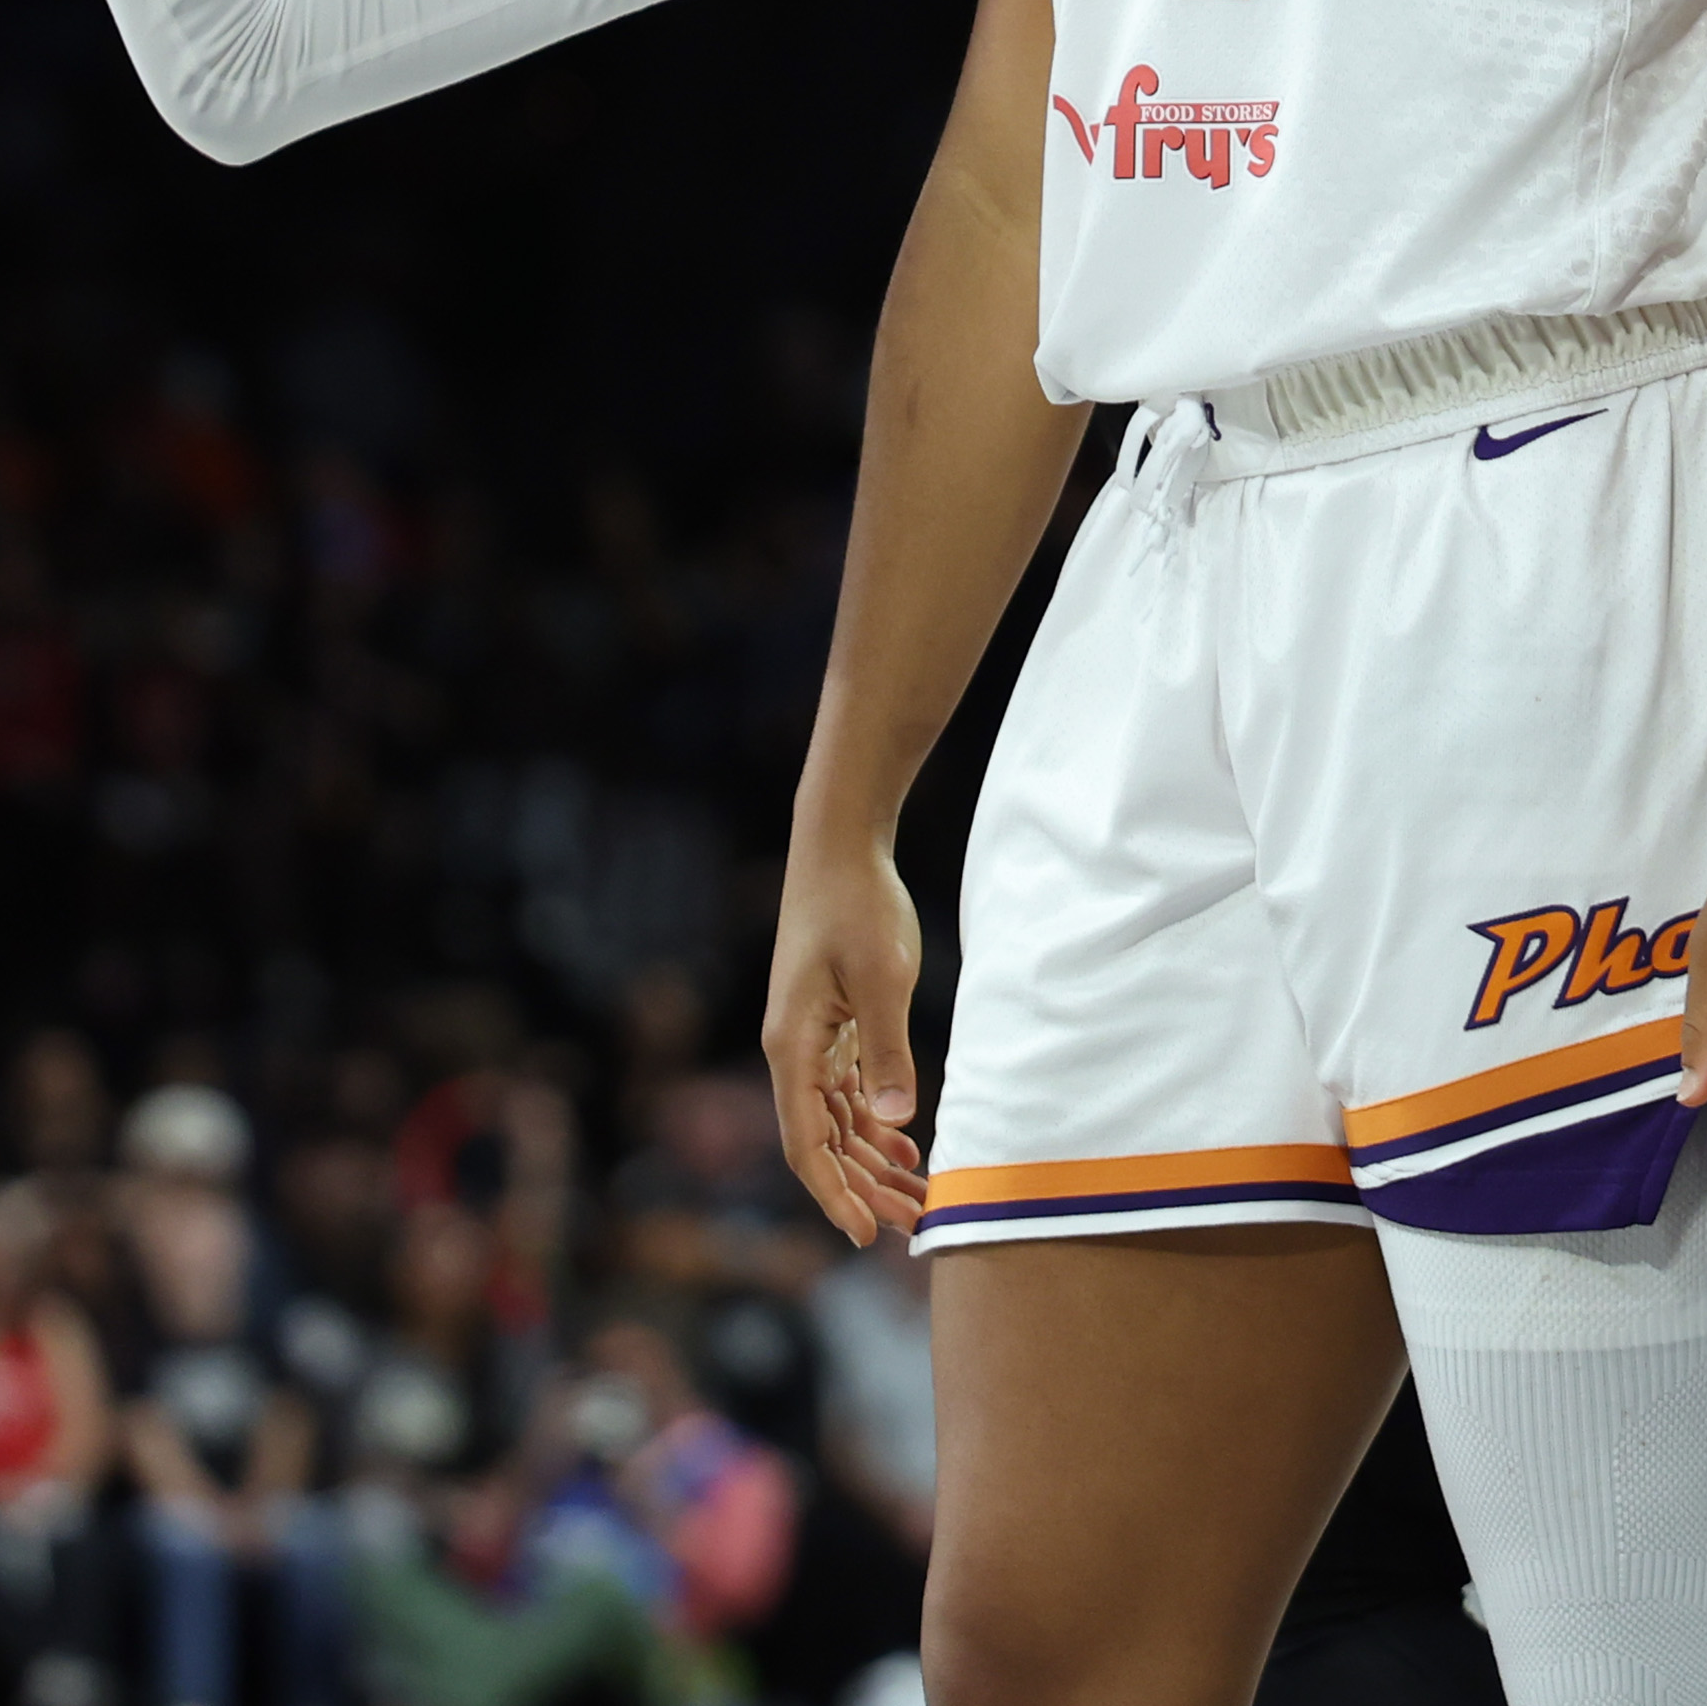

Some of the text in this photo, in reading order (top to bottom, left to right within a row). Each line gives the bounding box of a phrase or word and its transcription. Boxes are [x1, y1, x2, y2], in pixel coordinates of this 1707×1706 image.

[1103, 63, 1280, 190] fry's
[1140, 103, 1274, 123] FOOD STORES
